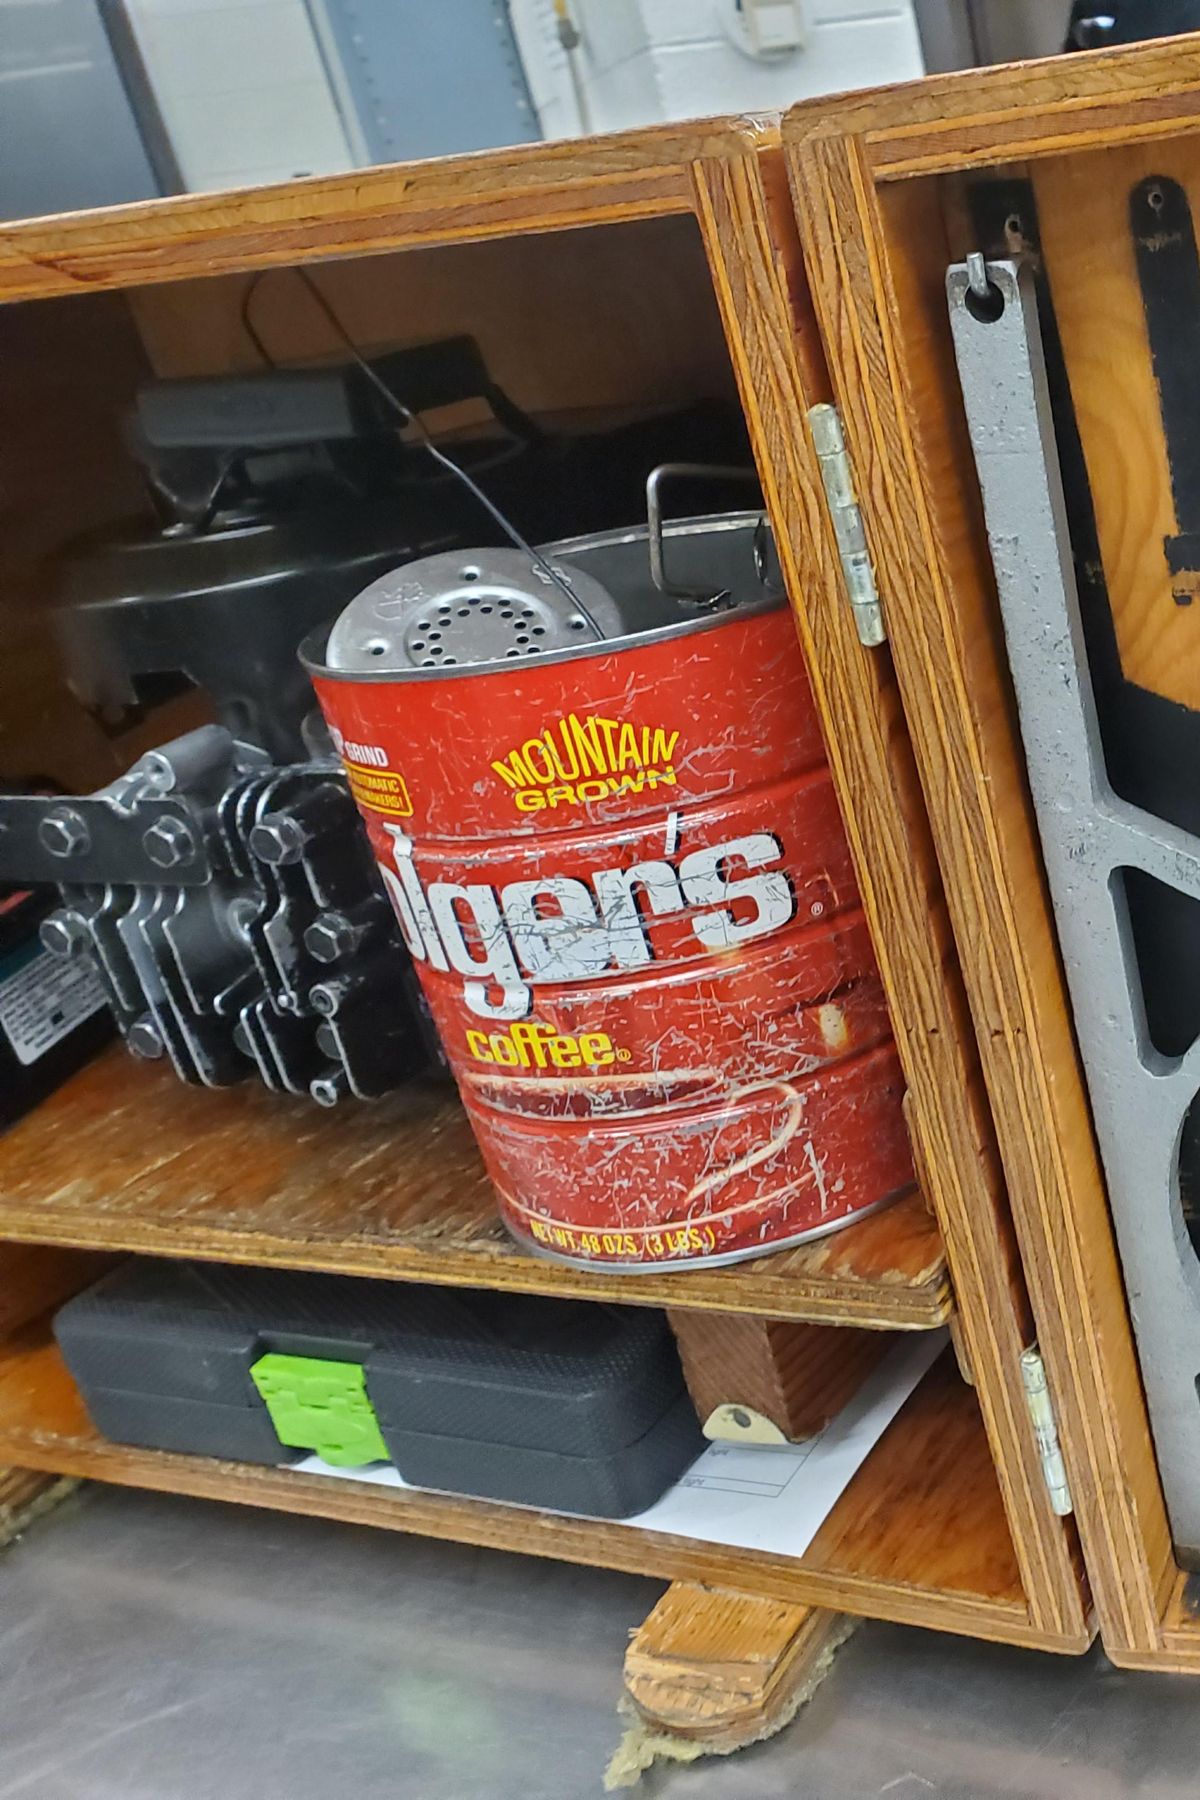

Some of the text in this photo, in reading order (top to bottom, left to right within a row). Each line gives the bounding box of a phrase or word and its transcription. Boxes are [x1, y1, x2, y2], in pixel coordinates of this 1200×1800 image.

[344, 741, 389, 768] GRIND
[490, 713, 680, 788] MOUNTAIN
[515, 765, 677, 812] GROWN
[465, 1023, 616, 1068] coffee
[582, 1233, 601, 1254] 48
[645, 1234, 664, 1257] (3
